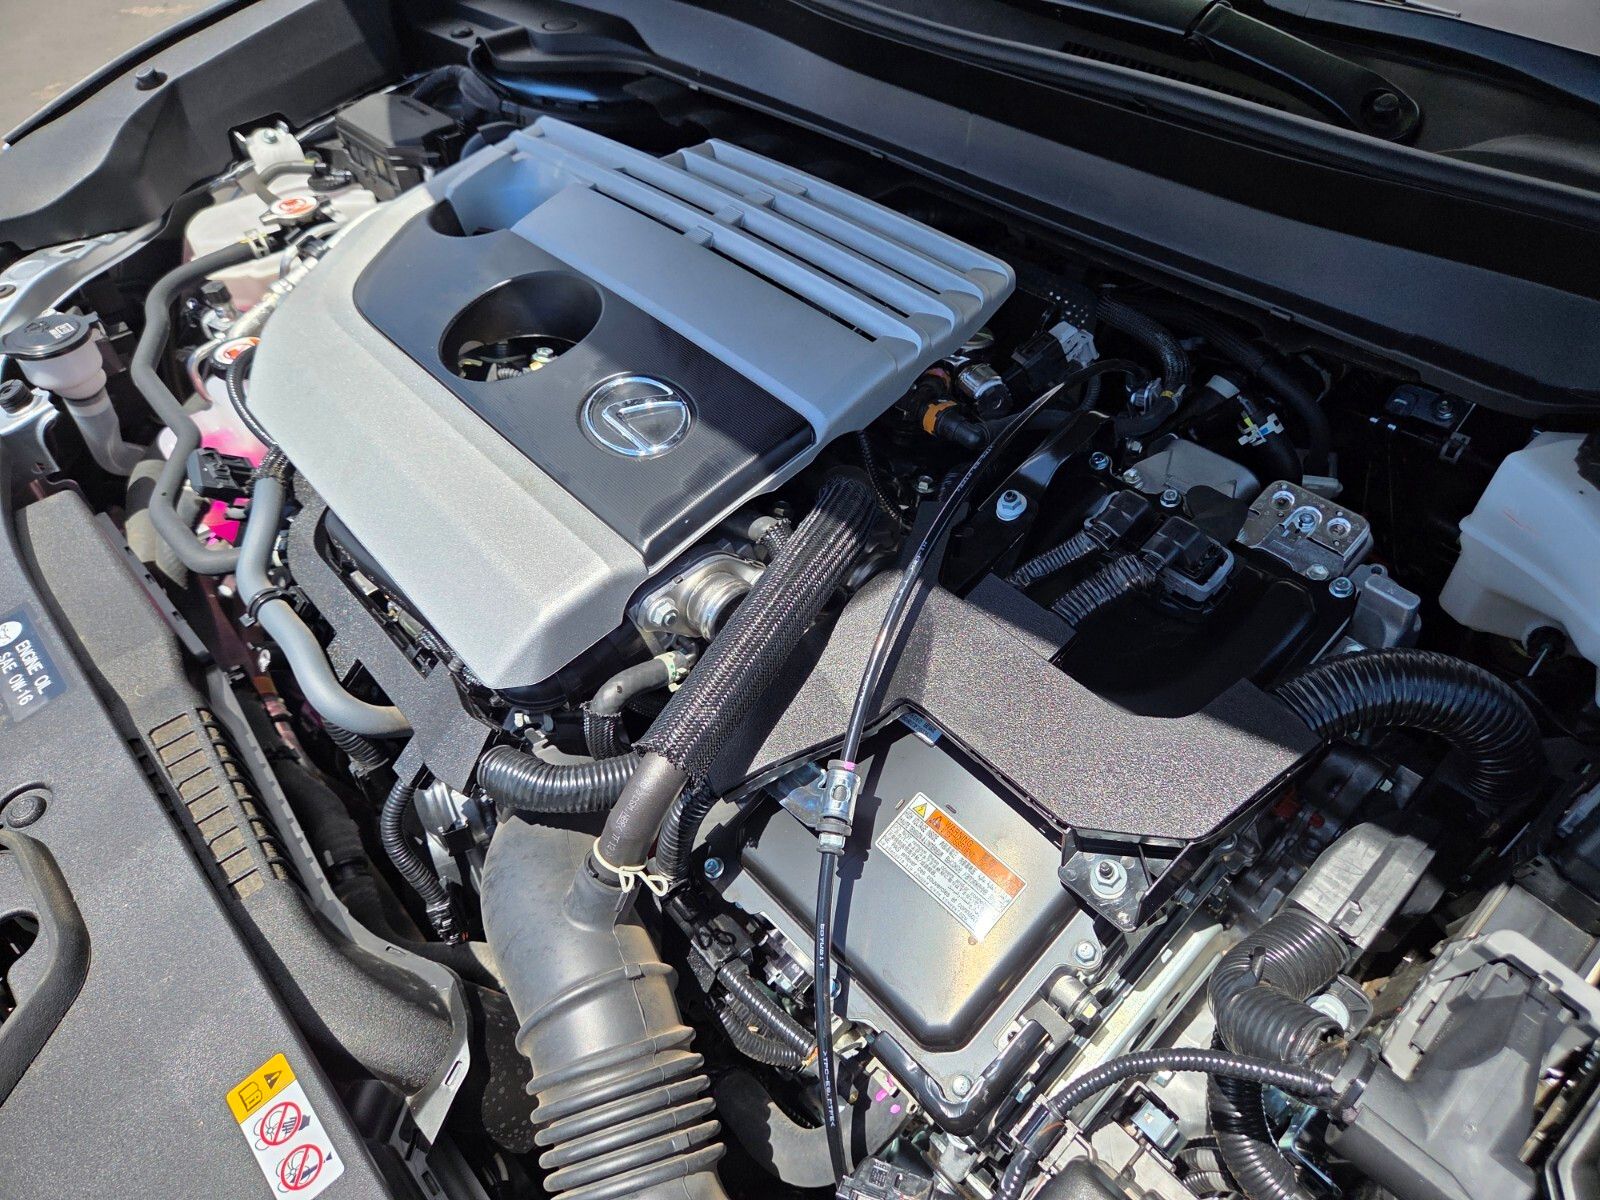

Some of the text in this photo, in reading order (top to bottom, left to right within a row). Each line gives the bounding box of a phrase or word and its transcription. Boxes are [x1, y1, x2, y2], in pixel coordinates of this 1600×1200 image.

[0, 651, 34, 706] SAE 0W-16
[15, 639, 52, 695] ENGINE OIL
[890, 841, 901, 852] PAS
[944, 820, 974, 847] WARNING
